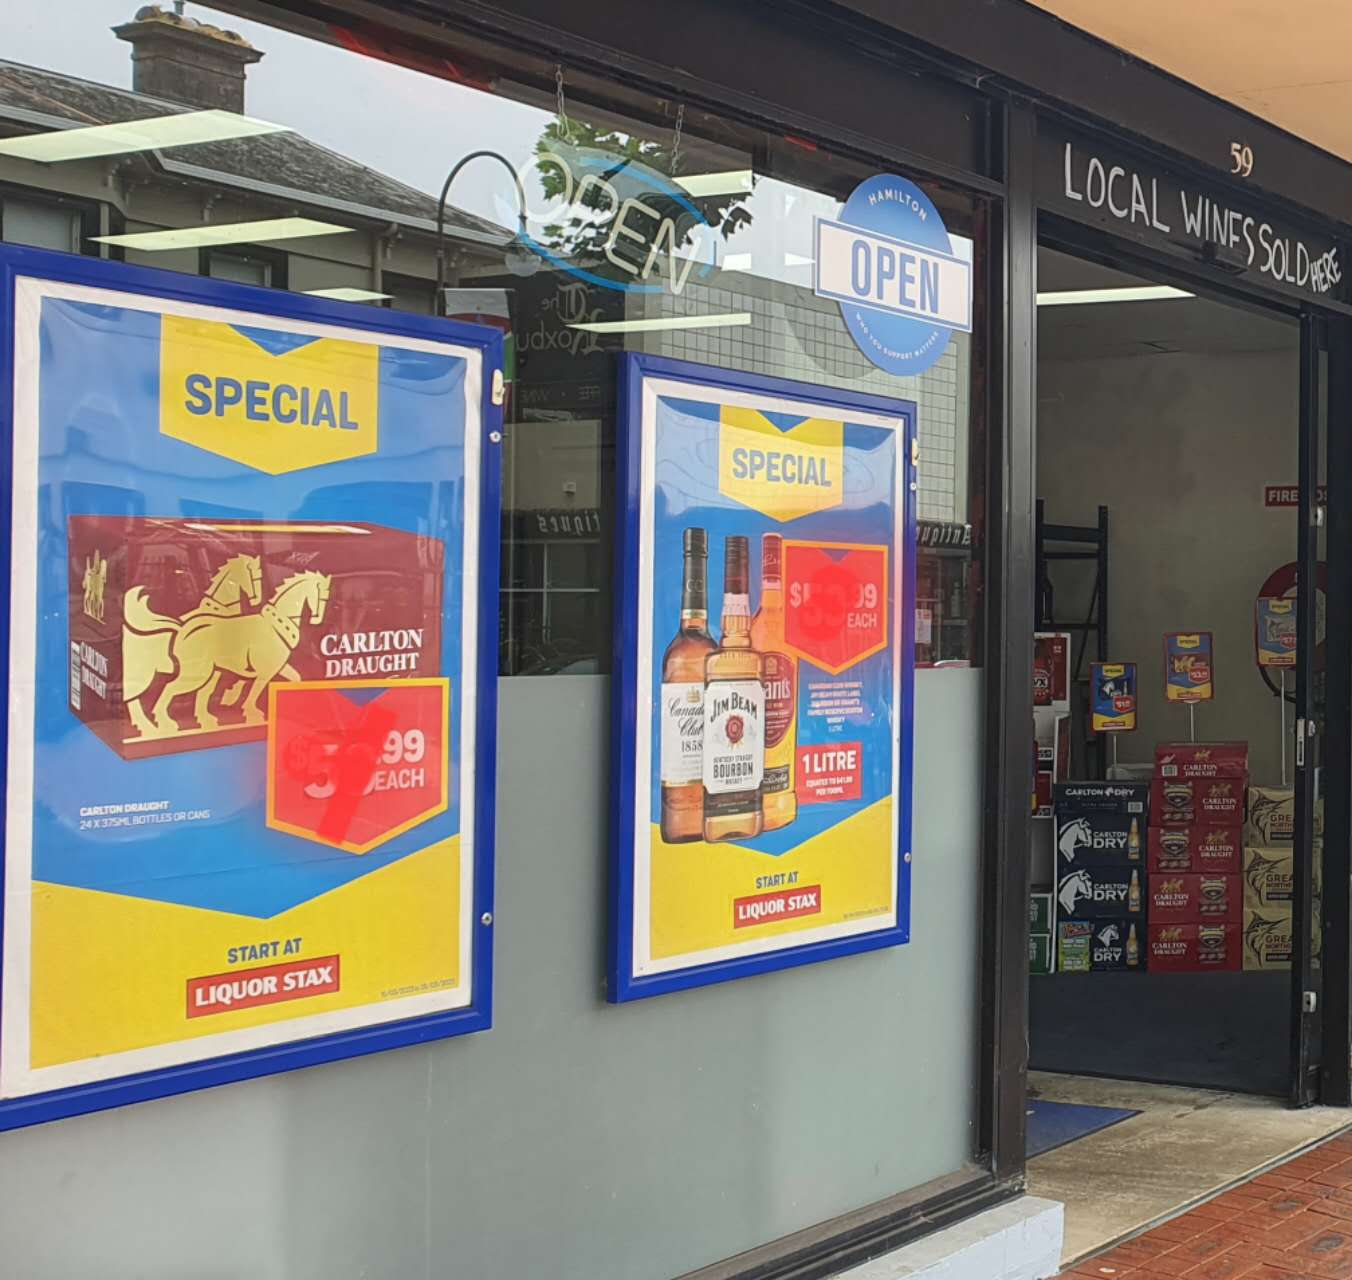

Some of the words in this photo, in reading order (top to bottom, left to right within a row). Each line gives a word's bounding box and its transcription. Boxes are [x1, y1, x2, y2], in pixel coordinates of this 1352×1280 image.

[1230, 141, 1254, 177] 59
[868, 188, 928, 223] HAMILTON
[1064, 142, 1170, 232] LOCAL
[1258, 223, 1310, 287] SOLD
[1309, 247, 1342, 293] HERE
[513, 150, 701, 297] OPEN
[851, 239, 940, 315] OPEN
[184, 372, 360, 431] SPECIAL
[731, 447, 833, 488] SPECIAL
[1268, 490, 1299, 502] FIRE
[847, 612, 878, 629] EACH
[320, 629, 424, 657] CARLTON
[324, 652, 420, 678] DRAUGHT
[710, 698, 729, 722] JIM
[731, 692, 758, 720] BEAM
[713, 761, 754, 779] BOURBON
[802, 753, 810, 774] 1
[813, 749, 857, 773] LITRE
[1183, 764, 1218, 772] CARLTON
[374, 768, 425, 791] EACH
[1065, 788, 1103, 797] CARLTON
[1114, 788, 1135, 797] DRY
[80, 803, 123, 817] CARLTON
[124, 800, 170, 814] DRAUGHT
[80, 819, 91, 830] 24
[92, 818, 100, 829] X
[132, 813, 172, 825] BOTTLES
[173, 811, 185, 821] OR
[187, 809, 211, 820] CANS
[1093, 831, 1128, 839] CARLTON
[1093, 838, 1127, 849] DRY
[755, 874, 786, 889] START
[787, 871, 799, 884] AT
[1093, 883, 1129, 891] CARLTON
[738, 899, 785, 920] LIQUOR
[788, 893, 817, 911] STAX
[1093, 890, 1127, 901] DRY
[227, 940, 281, 964] START
[283, 937, 302, 955] AT
[1093, 952, 1122, 963] DRY
[195, 976, 278, 1007] LIQUOR
[283, 965, 333, 991] STAX
